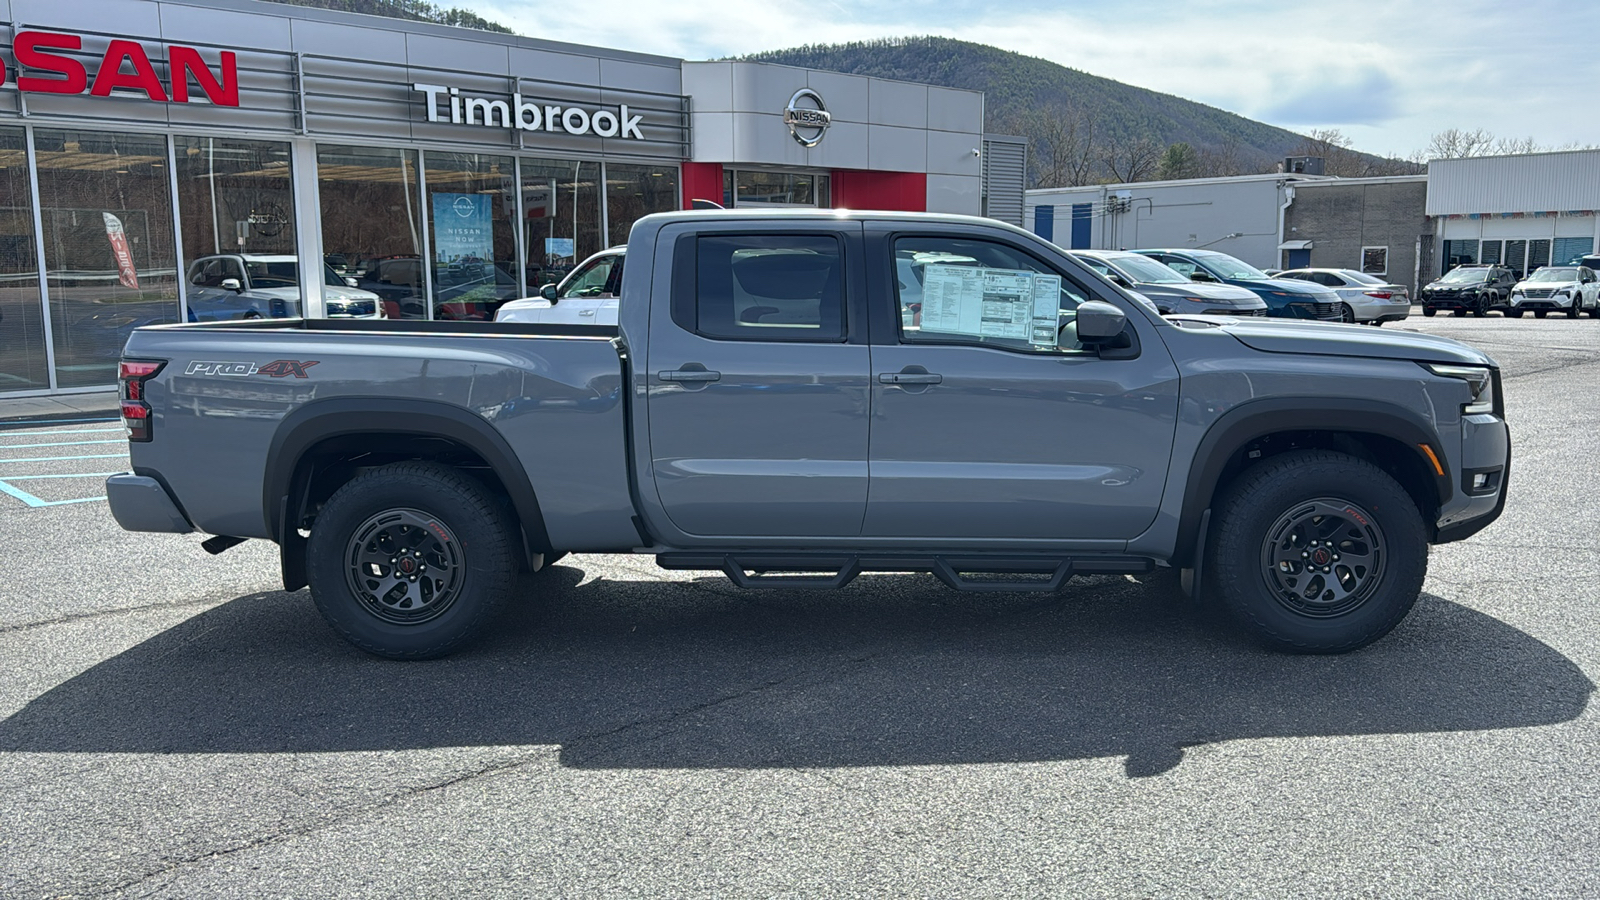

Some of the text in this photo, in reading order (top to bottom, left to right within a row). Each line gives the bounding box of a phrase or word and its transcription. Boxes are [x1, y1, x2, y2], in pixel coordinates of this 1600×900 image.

[0, 31, 239, 107] SAN
[413, 83, 645, 140] Timbrook
[790, 111, 829, 123] NISSAN
[1346, 508, 1367, 525] PRO
[429, 522, 449, 541] PRO
